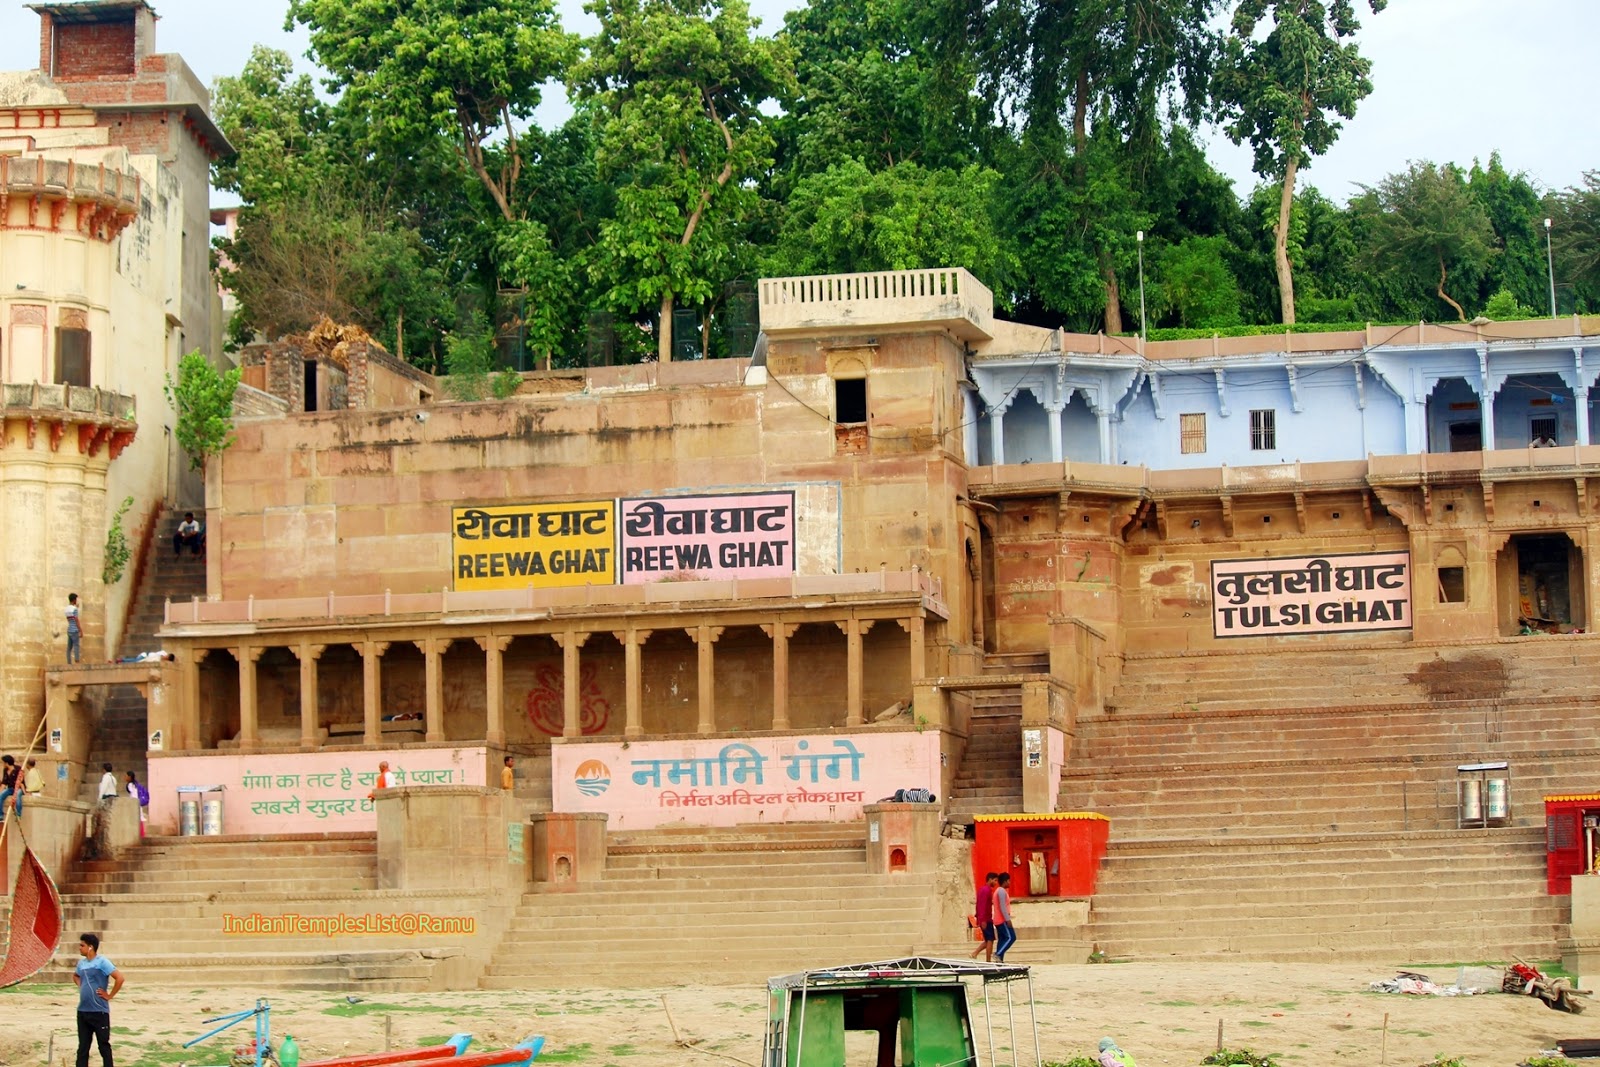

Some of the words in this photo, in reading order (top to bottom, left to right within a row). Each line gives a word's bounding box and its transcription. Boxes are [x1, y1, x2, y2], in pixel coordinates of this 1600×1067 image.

[457, 509, 533, 540] रीवा
[537, 509, 608, 537] घाट
[626, 501, 708, 537] रीवा
[711, 505, 789, 534] घाट
[458, 551, 547, 579] REEWA
[549, 548, 610, 574] GHAT
[626, 544, 713, 572] REEWA
[719, 541, 789, 568] GHAT
[1217, 559, 1332, 605] तुलसी
[1335, 564, 1406, 591] घाट
[1218, 603, 1311, 629] TULSI
[1315, 599, 1408, 624] GHAT
[242, 770, 273, 789] गंगा
[276, 775, 301, 788] का
[306, 774, 337, 787] तट
[340, 767, 353, 790] है
[410, 770, 453, 784] प्यारा
[631, 743, 768, 788] नमामि
[780, 740, 865, 783] गंगे
[251, 795, 301, 815] सबसे
[658, 789, 714, 807] निर्मल
[715, 789, 784, 806] अविरल
